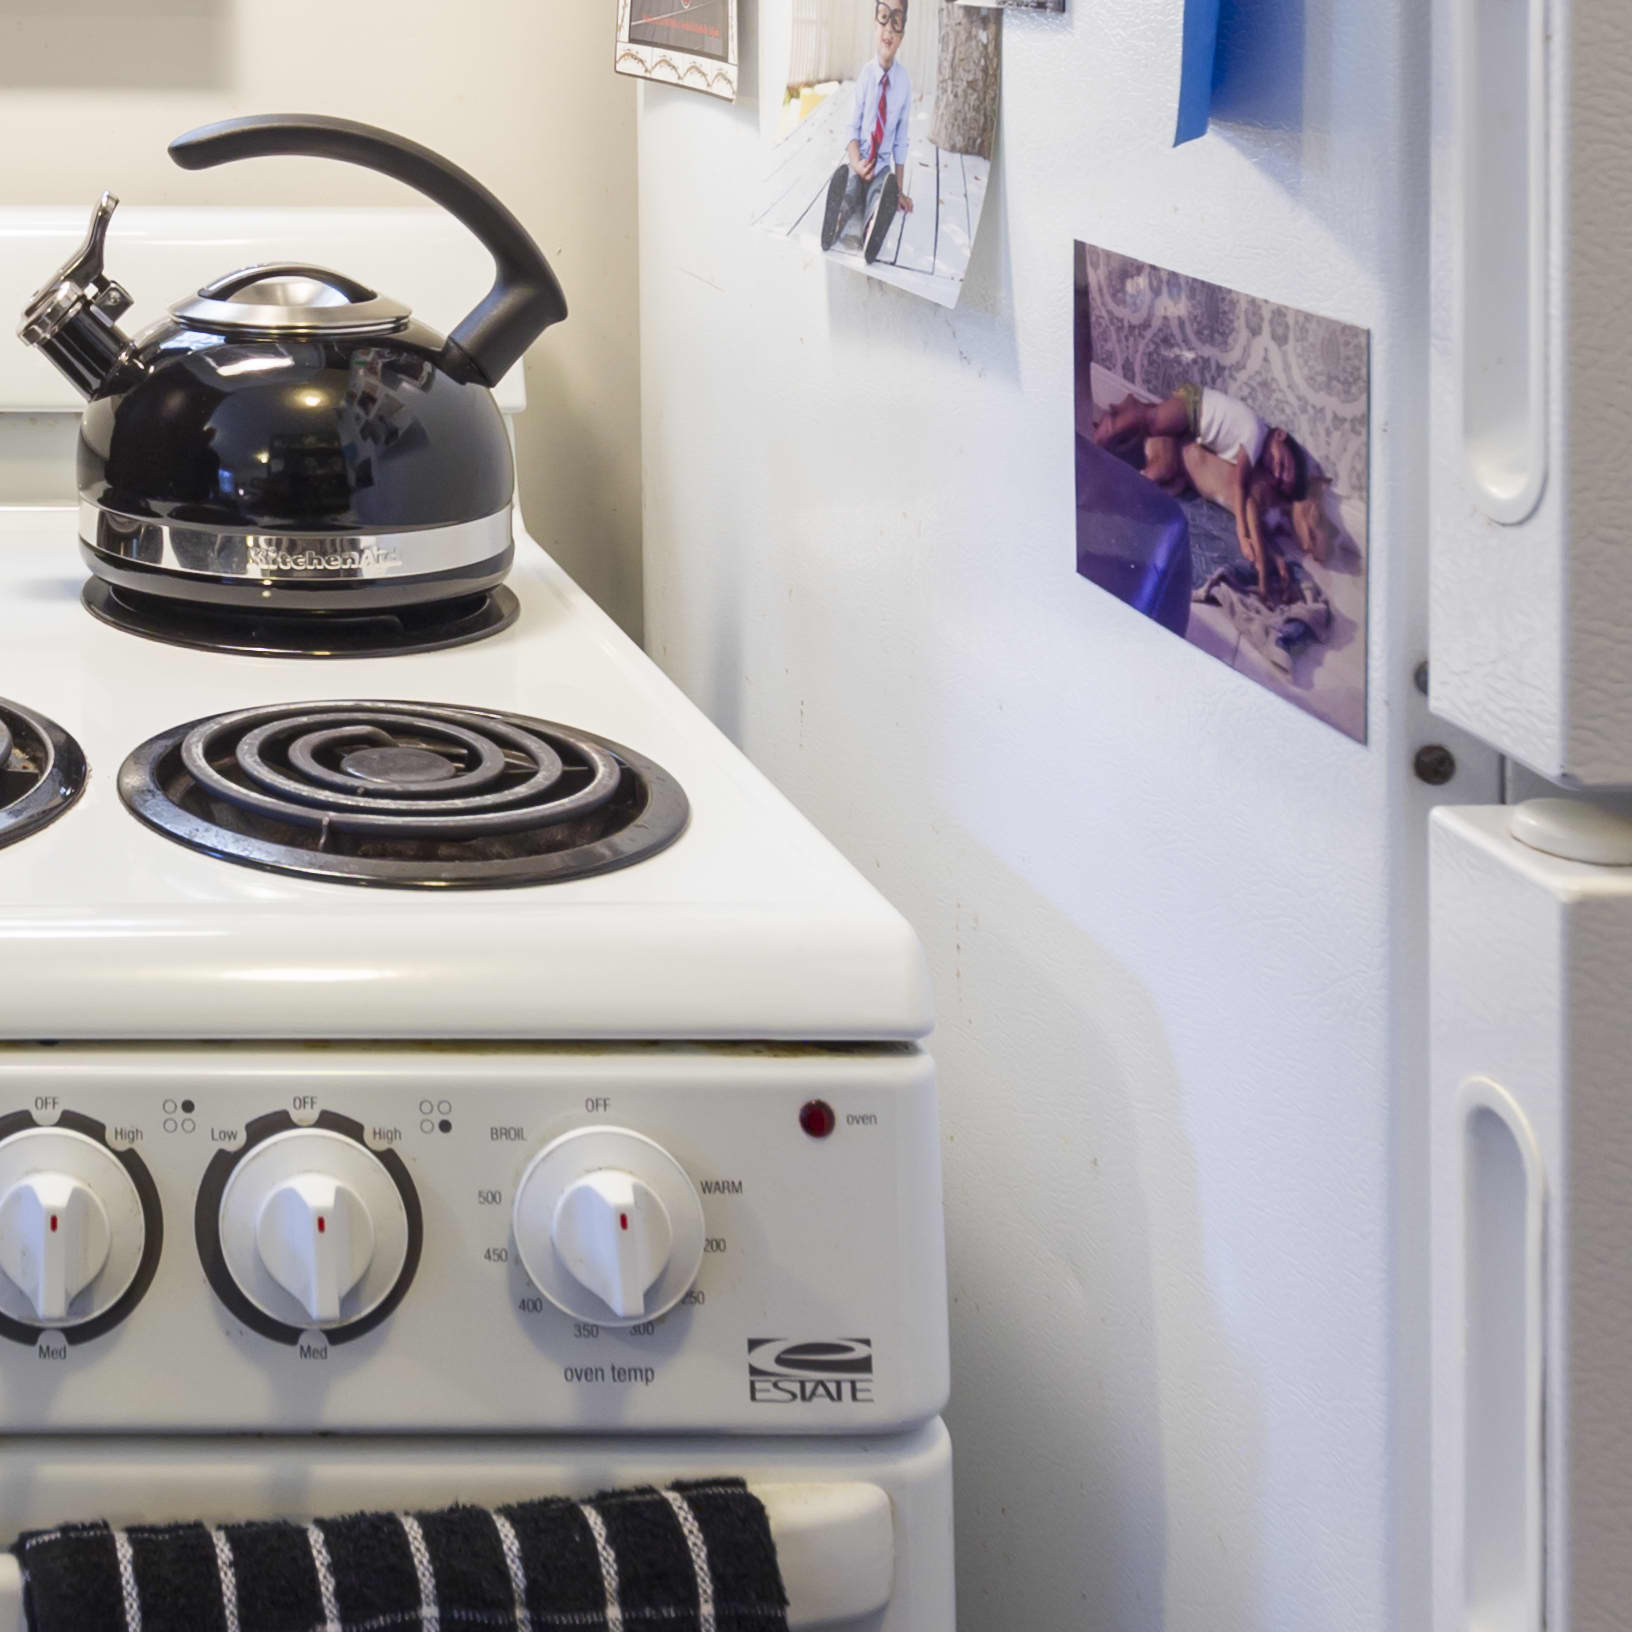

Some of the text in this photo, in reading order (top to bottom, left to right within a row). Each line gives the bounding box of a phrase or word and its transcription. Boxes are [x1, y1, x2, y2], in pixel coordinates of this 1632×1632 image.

[248, 544, 398, 570] KitchenAid
[34, 1095, 60, 1111] OFF
[292, 1095, 319, 1111] OFF
[585, 1097, 612, 1113] OFF
[846, 1112, 878, 1126] oven
[114, 1126, 144, 1144] High
[211, 1126, 238, 1143] Low
[372, 1126, 402, 1144] High
[490, 1126, 527, 1142] BROIL
[700, 1179, 744, 1196] WARM
[478, 1189, 503, 1205] 500
[703, 1238, 727, 1254] 200
[484, 1247, 508, 1264] 450
[518, 1298, 544, 1314] 400
[574, 1323, 600, 1340] 350
[38, 1345, 67, 1361] Med
[299, 1345, 328, 1361] Med
[563, 1362, 656, 1386] oven temp
[749, 1378, 875, 1404] ESTATE
